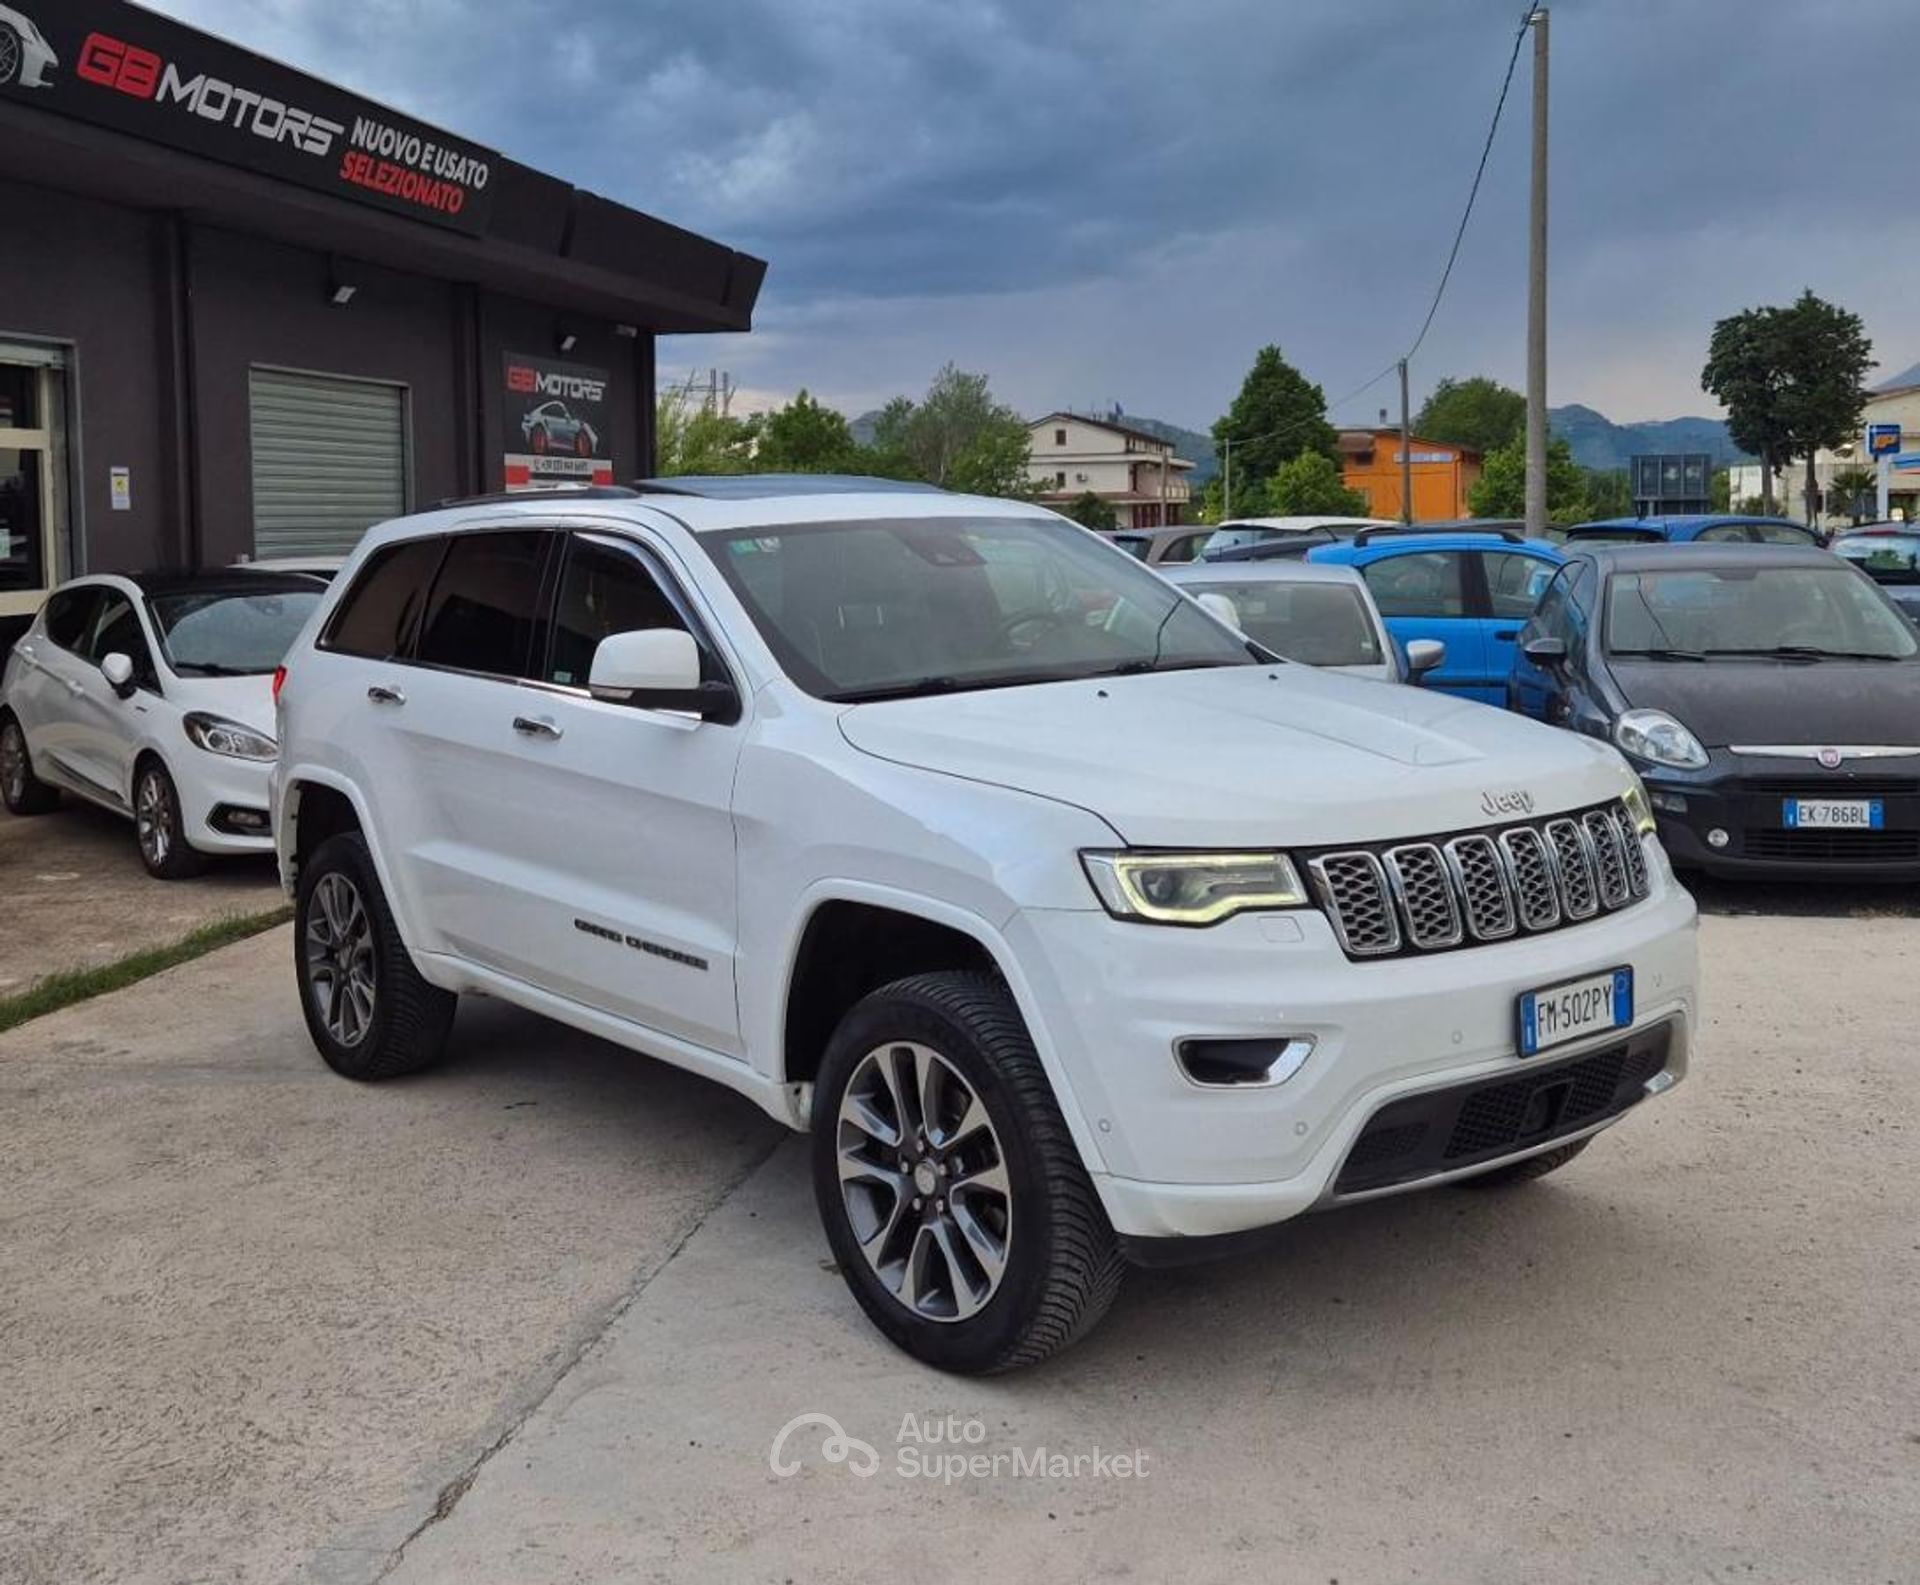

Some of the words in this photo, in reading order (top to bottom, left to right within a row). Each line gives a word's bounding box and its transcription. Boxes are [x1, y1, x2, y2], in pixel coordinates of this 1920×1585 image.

[340, 151, 464, 214] SELEZIONATO
[351, 116, 421, 165] NUOVO
[420, 143, 435, 171] E
[434, 148, 488, 189] USATO
[1481, 791, 1534, 816] Jeep
